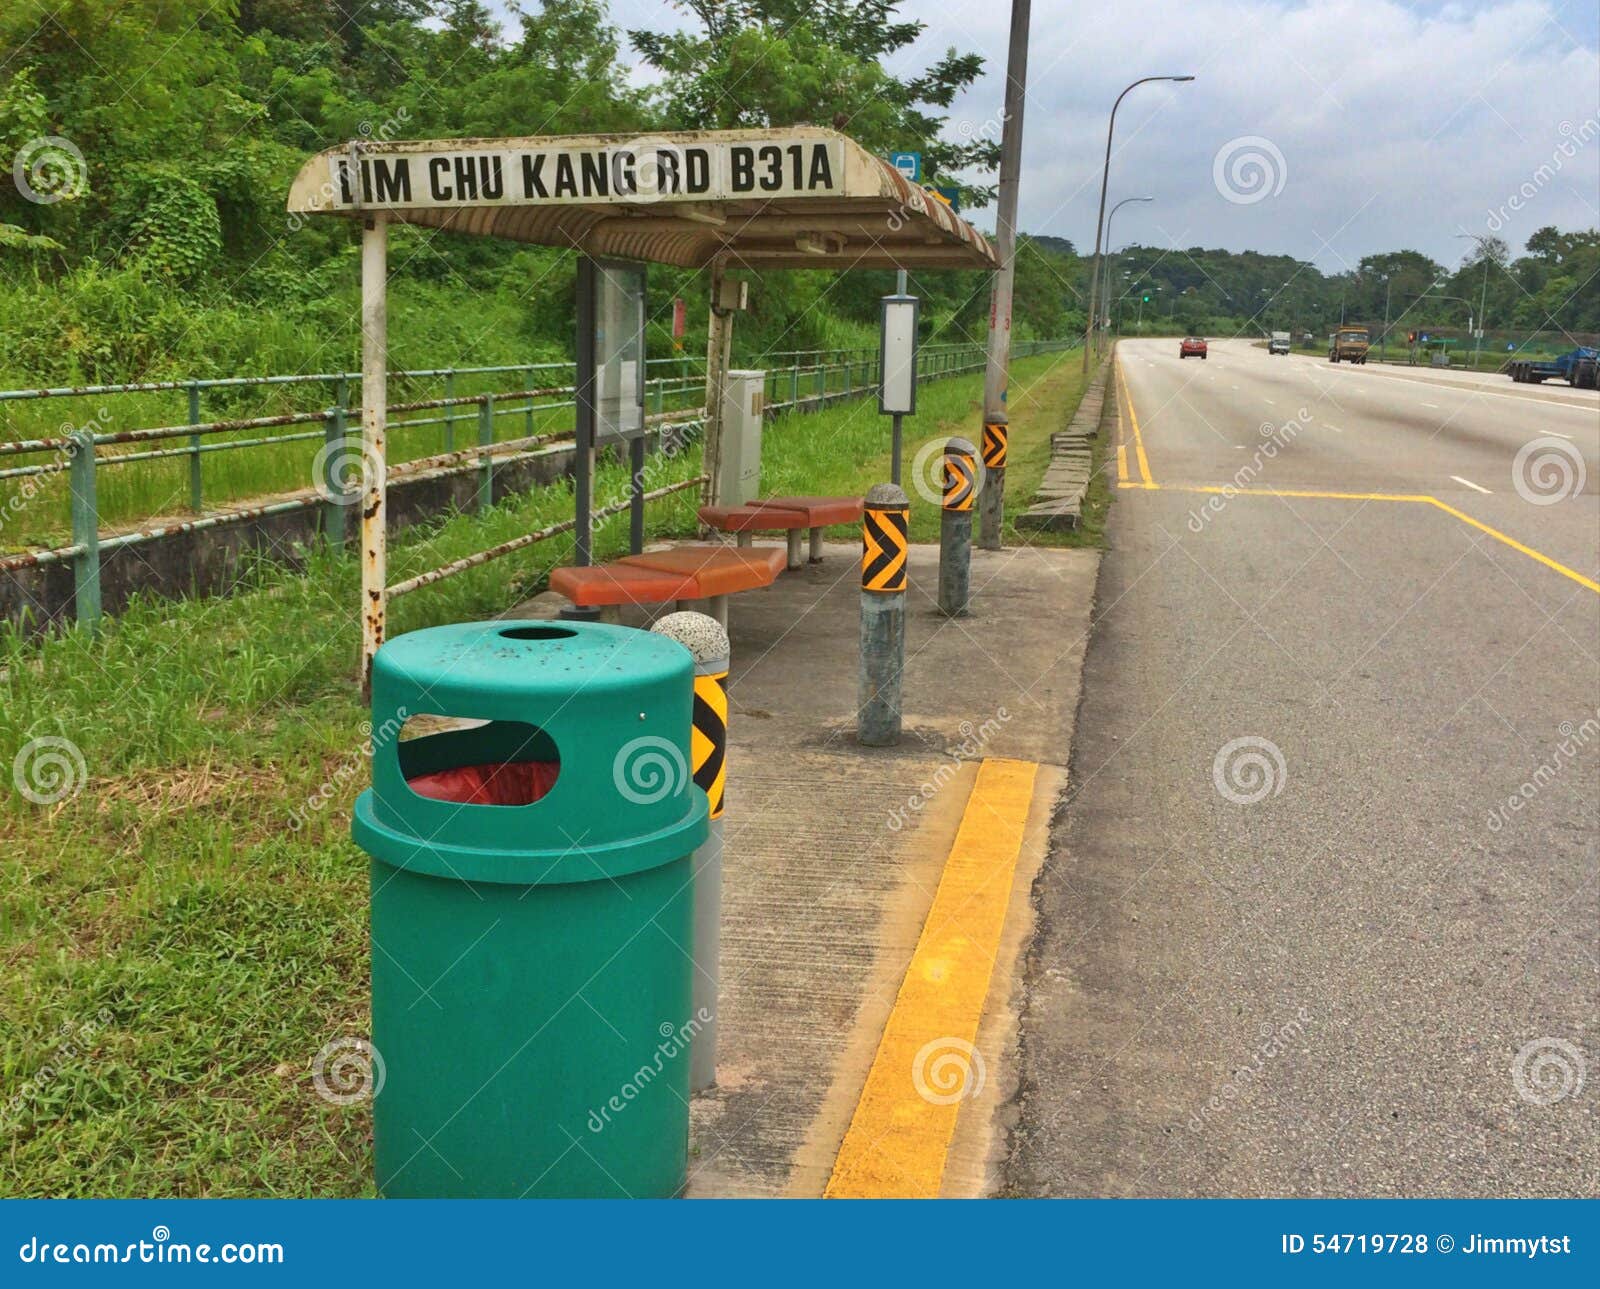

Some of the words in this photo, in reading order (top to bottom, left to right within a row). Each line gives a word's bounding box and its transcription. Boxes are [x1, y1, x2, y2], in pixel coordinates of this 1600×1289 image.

[338, 158, 412, 204] LIM
[429, 155, 503, 202] CHU
[521, 150, 637, 199] KANG
[656, 148, 710, 195] RD
[730, 144, 833, 192] B31A
